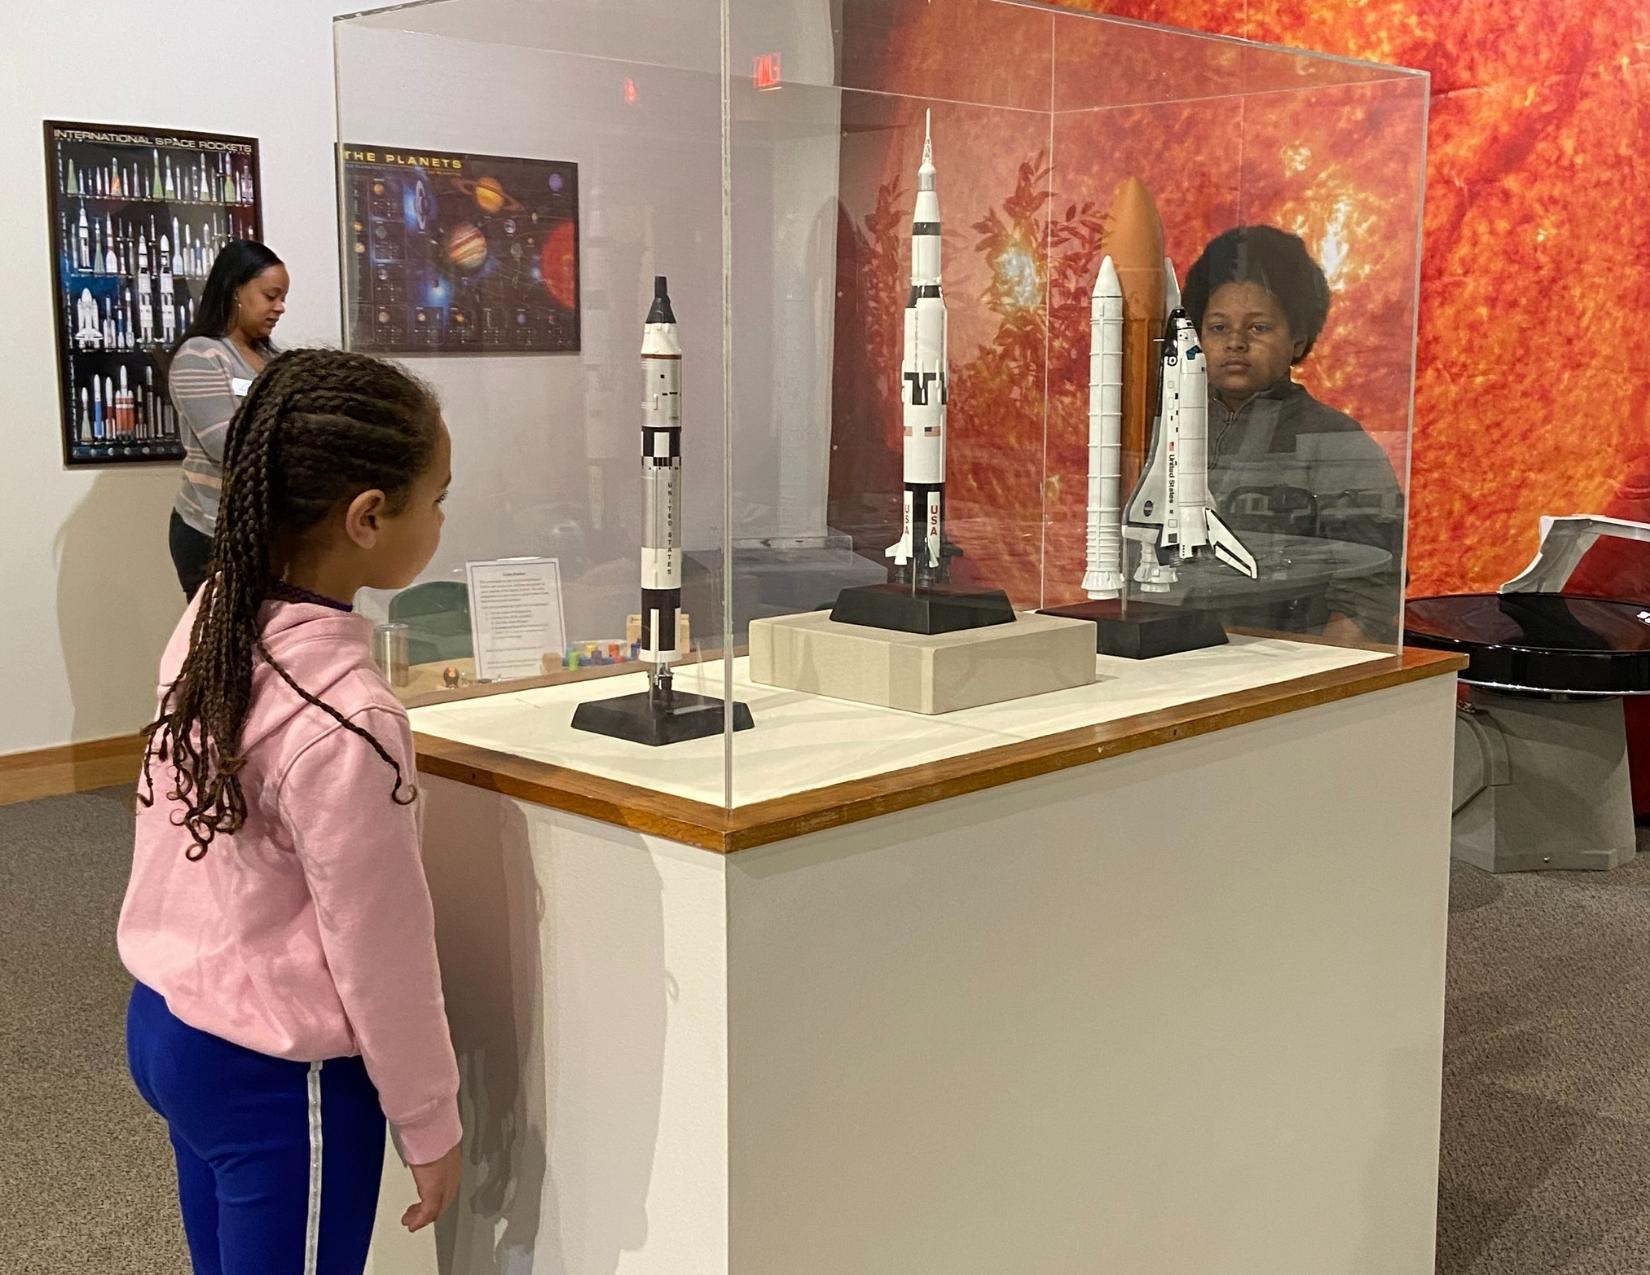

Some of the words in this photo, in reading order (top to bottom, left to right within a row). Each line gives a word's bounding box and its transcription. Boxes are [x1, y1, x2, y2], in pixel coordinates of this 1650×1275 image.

[54, 129, 153, 144] INTERNATIONAL
[155, 137, 196, 149] SPACE
[199, 141, 252, 153] ROCKETS
[343, 151, 376, 162] THE
[385, 154, 462, 169] PLANETS
[930, 505, 938, 536] USA
